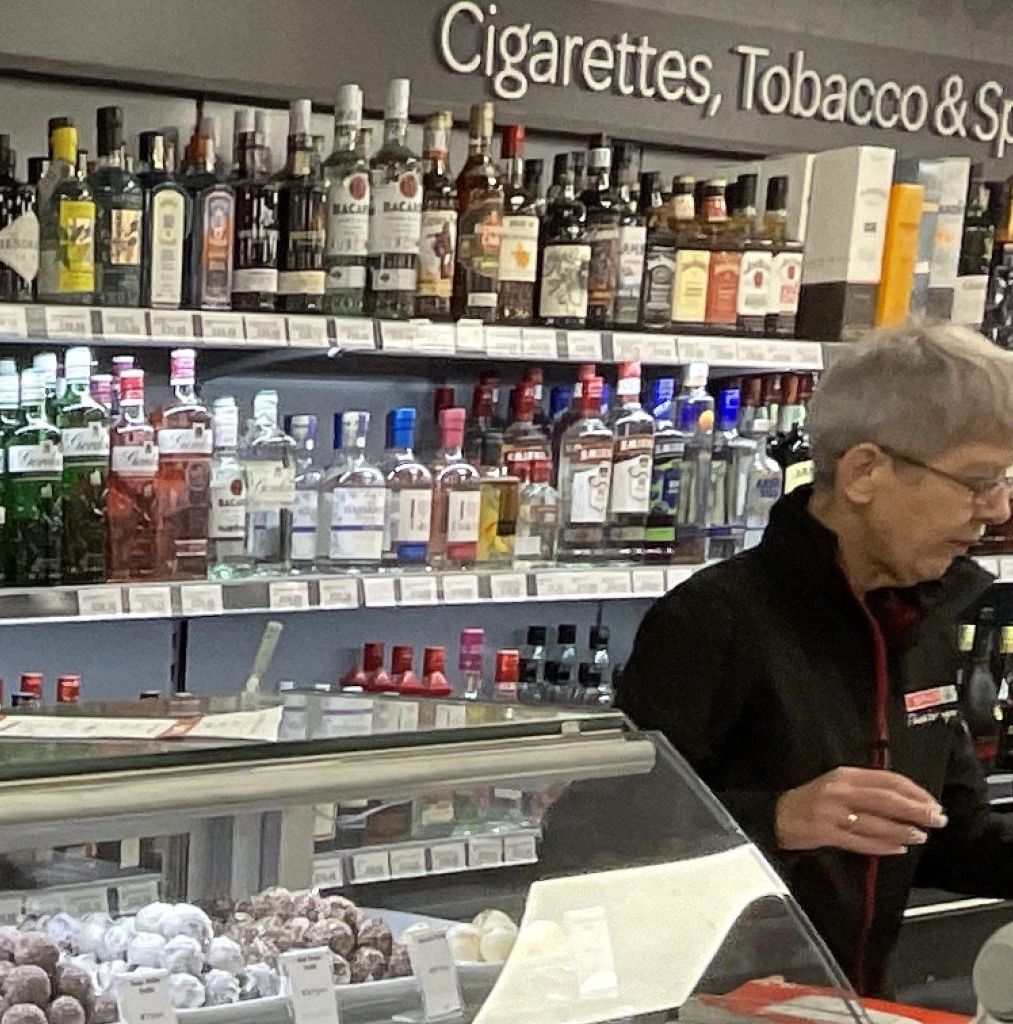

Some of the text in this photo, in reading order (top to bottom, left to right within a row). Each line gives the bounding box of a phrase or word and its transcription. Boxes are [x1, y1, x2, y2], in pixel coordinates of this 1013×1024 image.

[441, 1, 721, 117] Cigarettes,
[738, 45, 928, 131] Tobacco
[934, 74, 967, 137] &
